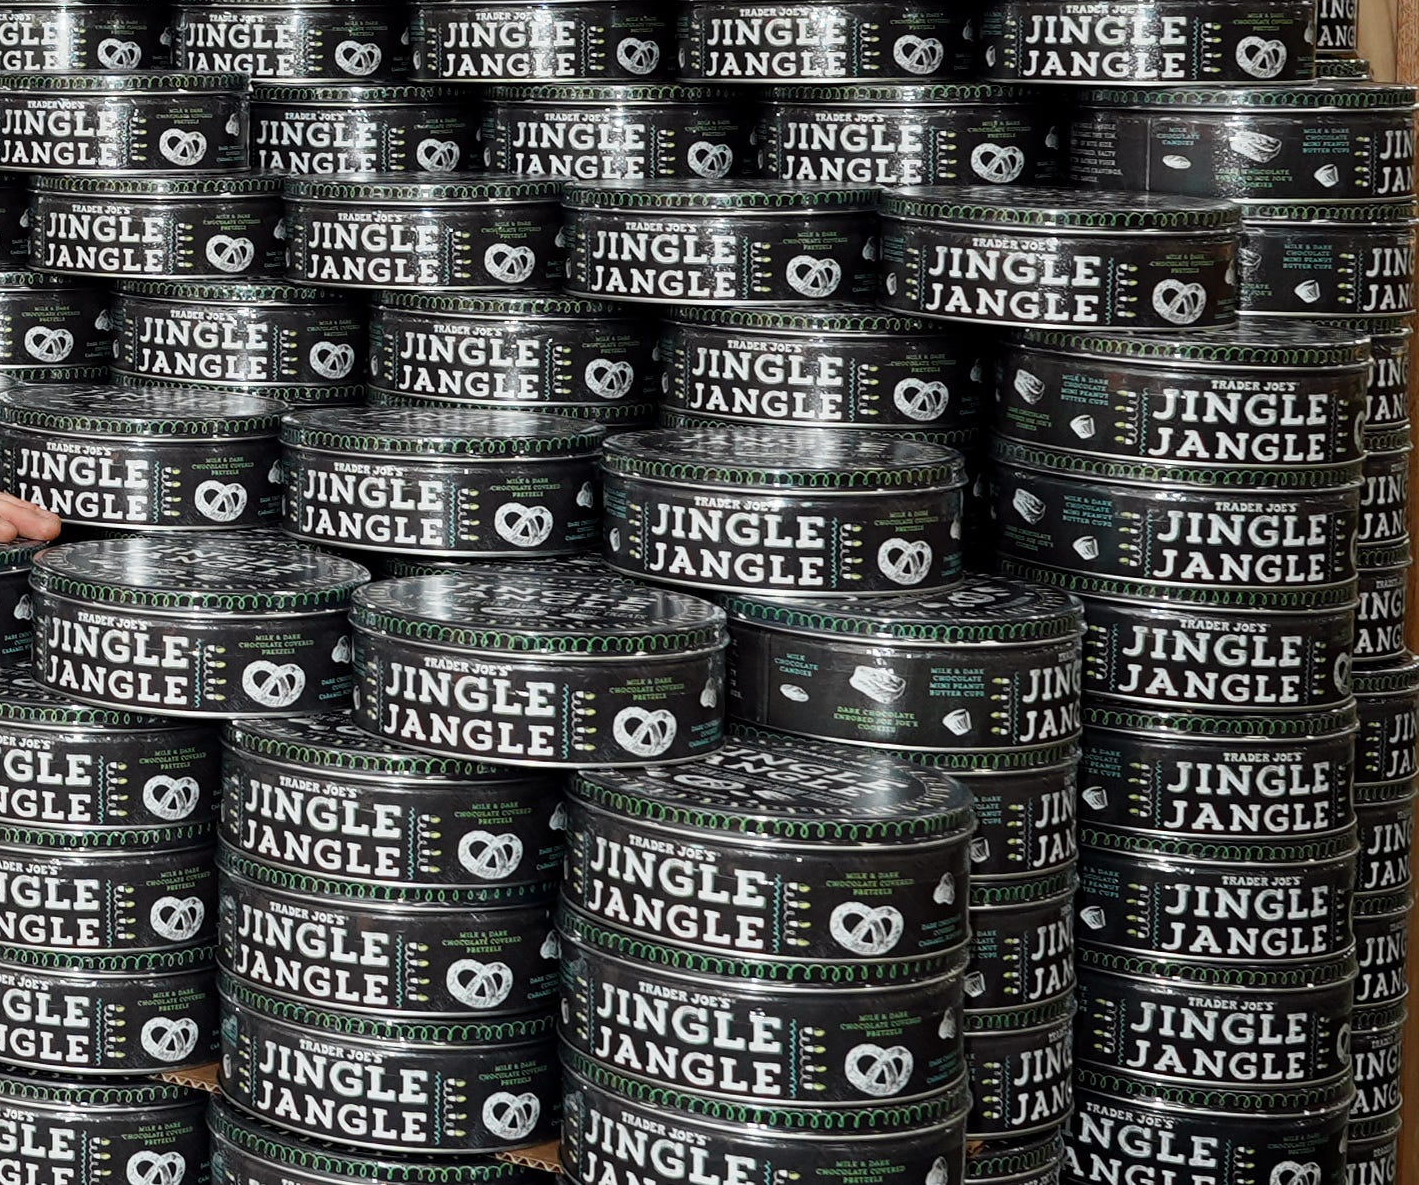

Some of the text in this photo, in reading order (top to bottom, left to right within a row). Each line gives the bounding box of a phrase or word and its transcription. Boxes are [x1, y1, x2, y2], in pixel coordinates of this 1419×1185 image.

[1025, 15, 1187, 46] JINGLE
[1023, 48, 1185, 79] JANGLE
[1, 109, 118, 140] JINGLE
[783, 122, 922, 153] JINGLE
[0, 141, 119, 167] JANGLE
[781, 155, 922, 183] JANGLE
[310, 220, 439, 254] JINGLE
[625, 221, 697, 233] TRADER JOE'S
[971, 236, 1056, 252] TRADER JOE'S
[593, 233, 737, 266] JINGLE
[928, 245, 1102, 288] JINGLE
[307, 256, 439, 285] JANGLE
[590, 265, 736, 299] JANGLE
[924, 285, 1100, 322] JANGLE
[139, 316, 268, 351] JINGLE
[138, 350, 268, 381] JANGLE
[1211, 380, 1297, 392] TRADER JOE'S
[1153, 388, 1329, 425] JINGLE
[1148, 426, 1326, 462] JANGLE
[333, 462, 404, 478] TRADER JOE'S
[303, 470, 444, 512] JINGLE
[301, 508, 444, 547] JANGLE
[652, 503, 825, 549] JINGLE
[650, 542, 825, 587] JANGLE
[77, 612, 150, 631] TRADER JOE'S
[48, 619, 191, 670] JINGLE
[1123, 626, 1304, 669] JINGLE
[46, 657, 189, 708] JANGLE
[425, 656, 511, 676] TRADER JOE'S
[1118, 664, 1302, 704] JANGLE
[384, 661, 556, 719] JINGLE
[383, 704, 555, 757] JANGLE
[629, 833, 720, 862] TRADER JOE'S
[590, 837, 765, 909] JINGLE
[588, 883, 765, 950] JANGLE
[239, 903, 391, 967] JINGLE
[237, 949, 389, 1007] JANGLE
[1131, 1001, 1308, 1044] JINGLE
[1127, 1041, 1306, 1080] JANGLE
